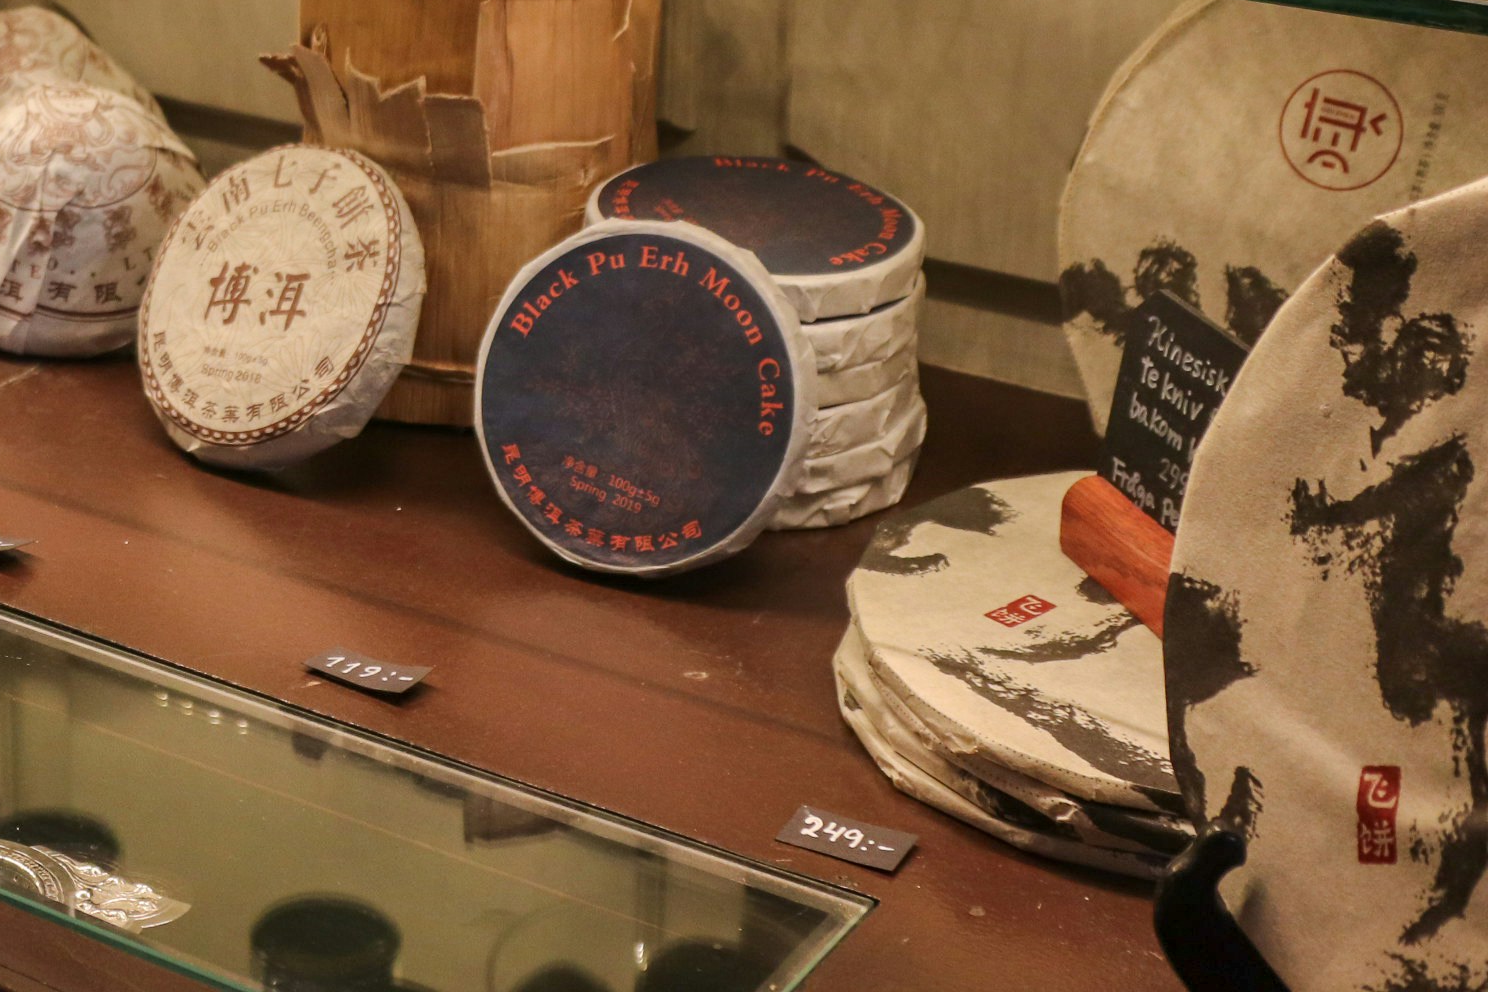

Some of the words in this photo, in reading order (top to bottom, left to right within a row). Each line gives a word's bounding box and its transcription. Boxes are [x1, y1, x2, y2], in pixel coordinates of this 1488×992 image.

[249, 205, 269, 218] Pu
[272, 199, 296, 213] Erh
[828, 242, 888, 267] Cake
[510, 268, 579, 338] Black
[586, 251, 626, 276] Pu
[639, 246, 690, 277] Erh
[698, 266, 763, 346] Moon
[758, 358, 784, 437] Cake
[1129, 391, 1183, 452] bakom
[569, 475, 608, 503] Spring
[612, 493, 642, 514] 2019
[800, 813, 896, 852] 249:-
